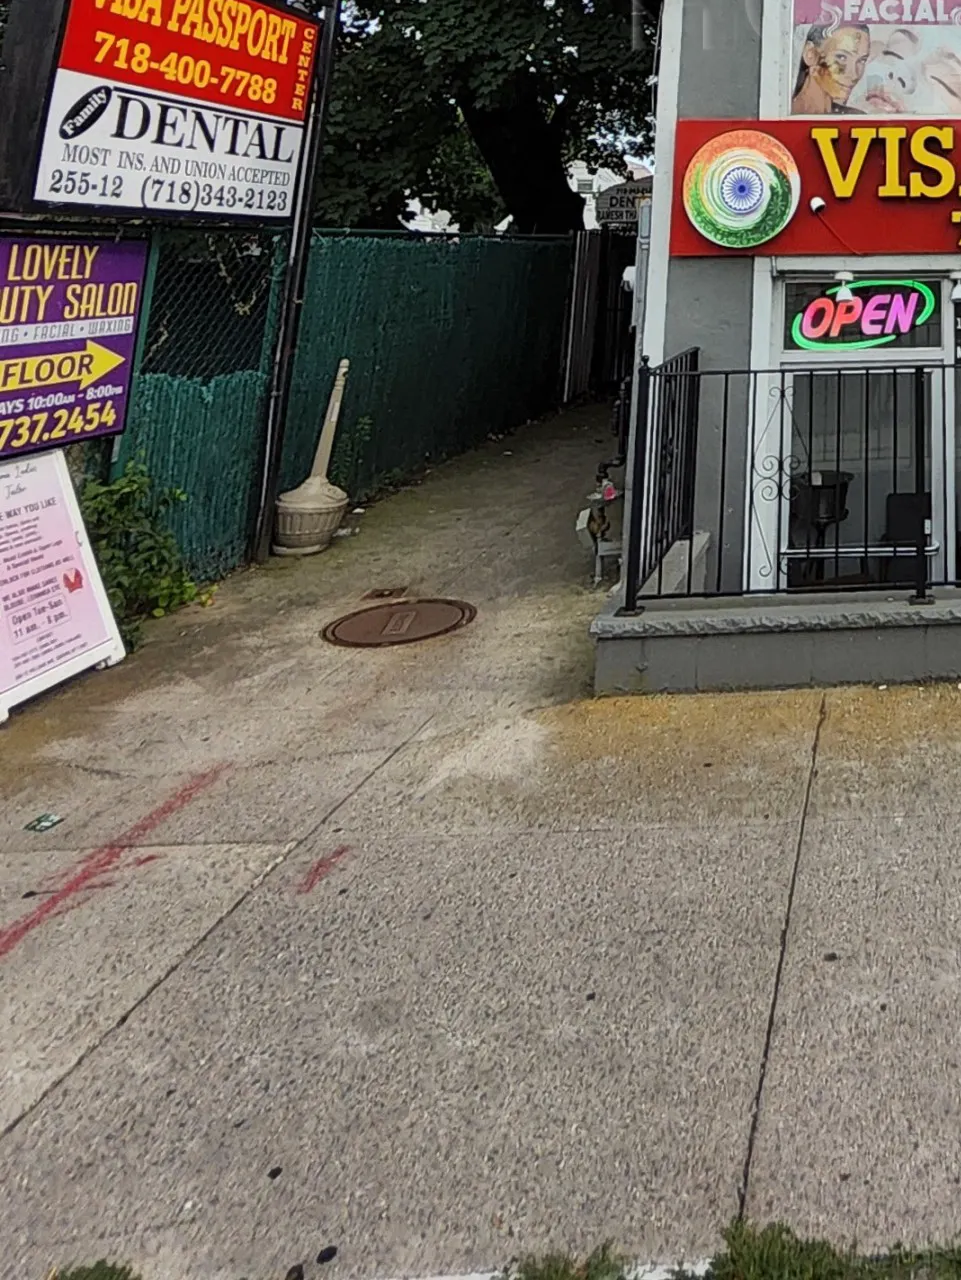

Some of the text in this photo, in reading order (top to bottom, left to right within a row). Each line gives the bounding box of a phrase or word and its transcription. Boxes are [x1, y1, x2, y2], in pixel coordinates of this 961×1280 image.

[94, 31, 278, 104] 718-400-7788
[291, 27, 316, 111] CENTER
[61, 89, 107, 137] Family
[110, 95, 296, 164] DENTAL
[49, 169, 124, 199] 255-12
[61, 142, 290, 187] MOST INS. AND UNION ACCEPTED
[7, 244, 99, 281] LOVELY
[63, 282, 138, 319] SALON
[801, 293, 920, 339] OPEN
[33, 323, 76, 341] FACIAL
[88, 318, 131, 335] WAXING
[1, 353, 95, 388] FLOOR
[24, 501, 40, 513] YOU
